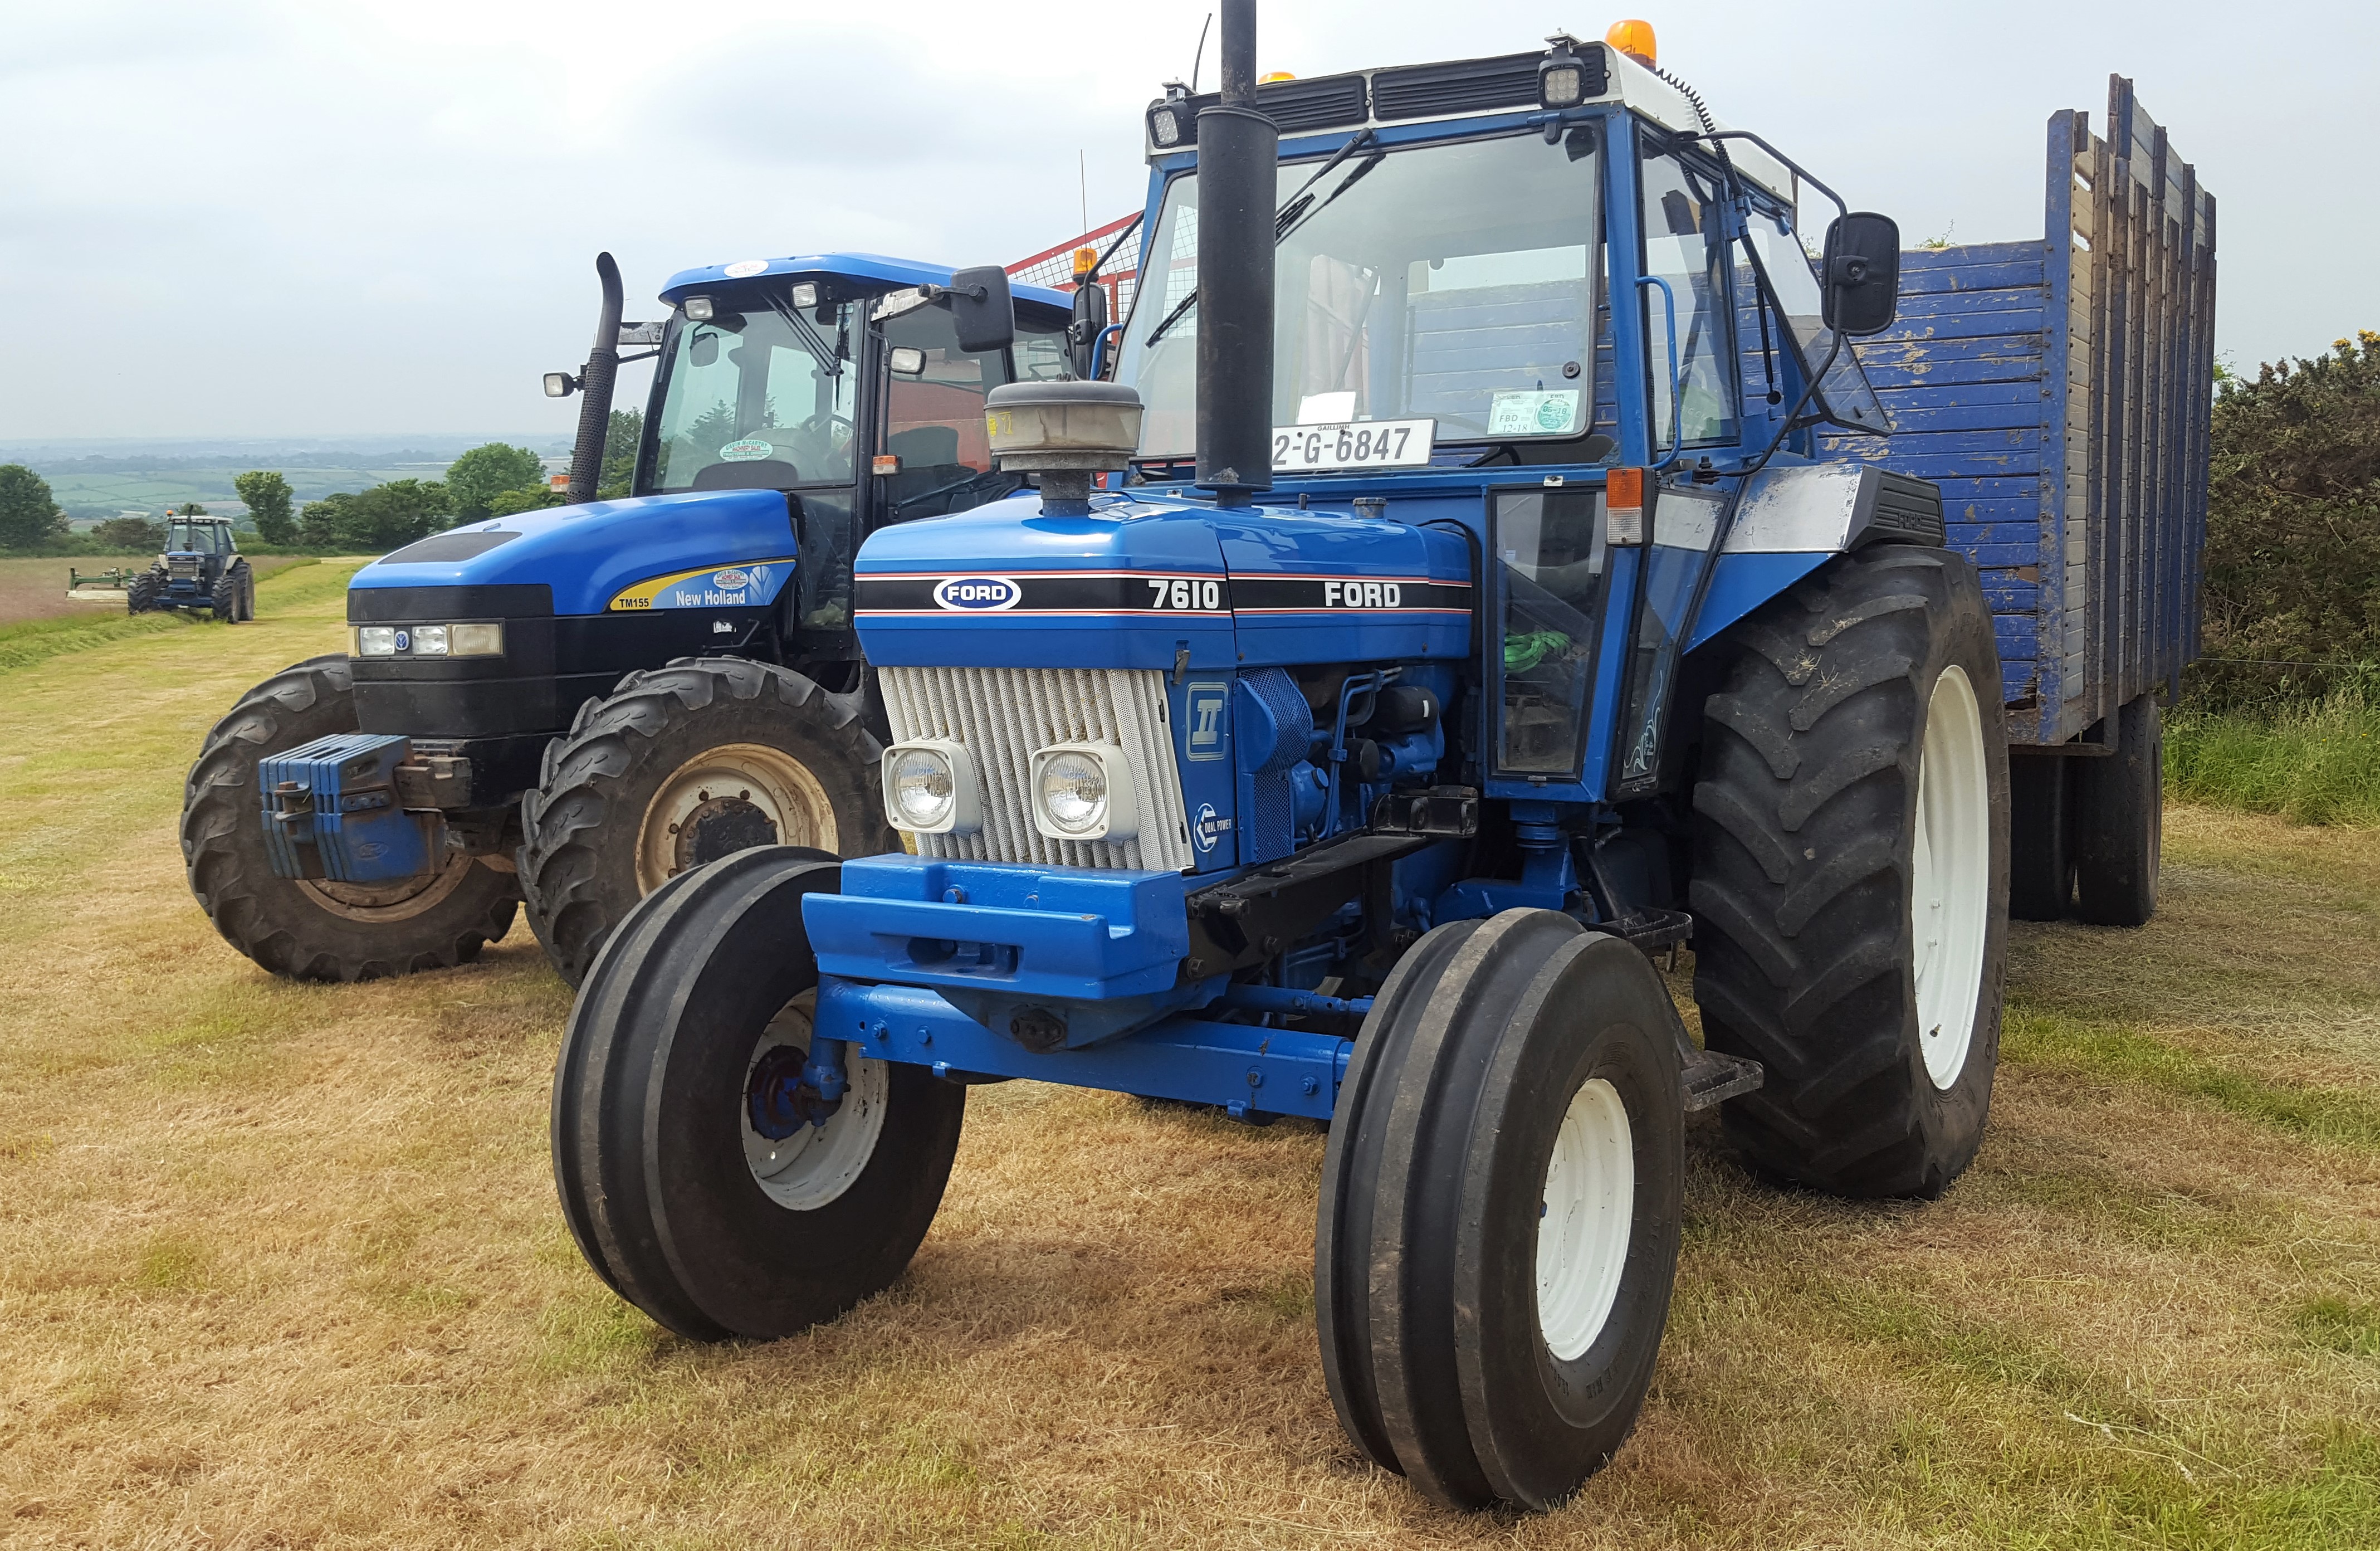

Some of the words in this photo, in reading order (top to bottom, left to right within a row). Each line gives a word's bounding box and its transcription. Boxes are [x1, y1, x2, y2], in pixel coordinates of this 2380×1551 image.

[1543, 406, 1567, 414] 06-18
[1503, 424, 1528, 432] 12-18
[676, 591, 701, 606] New
[705, 589, 745, 605] Holland
[947, 586, 1006, 601] FORD
[1148, 580, 1219, 609] 7610
[1325, 582, 1400, 607] FORD
[619, 598, 649, 608] TM155
[1204, 821, 1216, 833] DUAL
[1216, 818, 1231, 832] POWER
